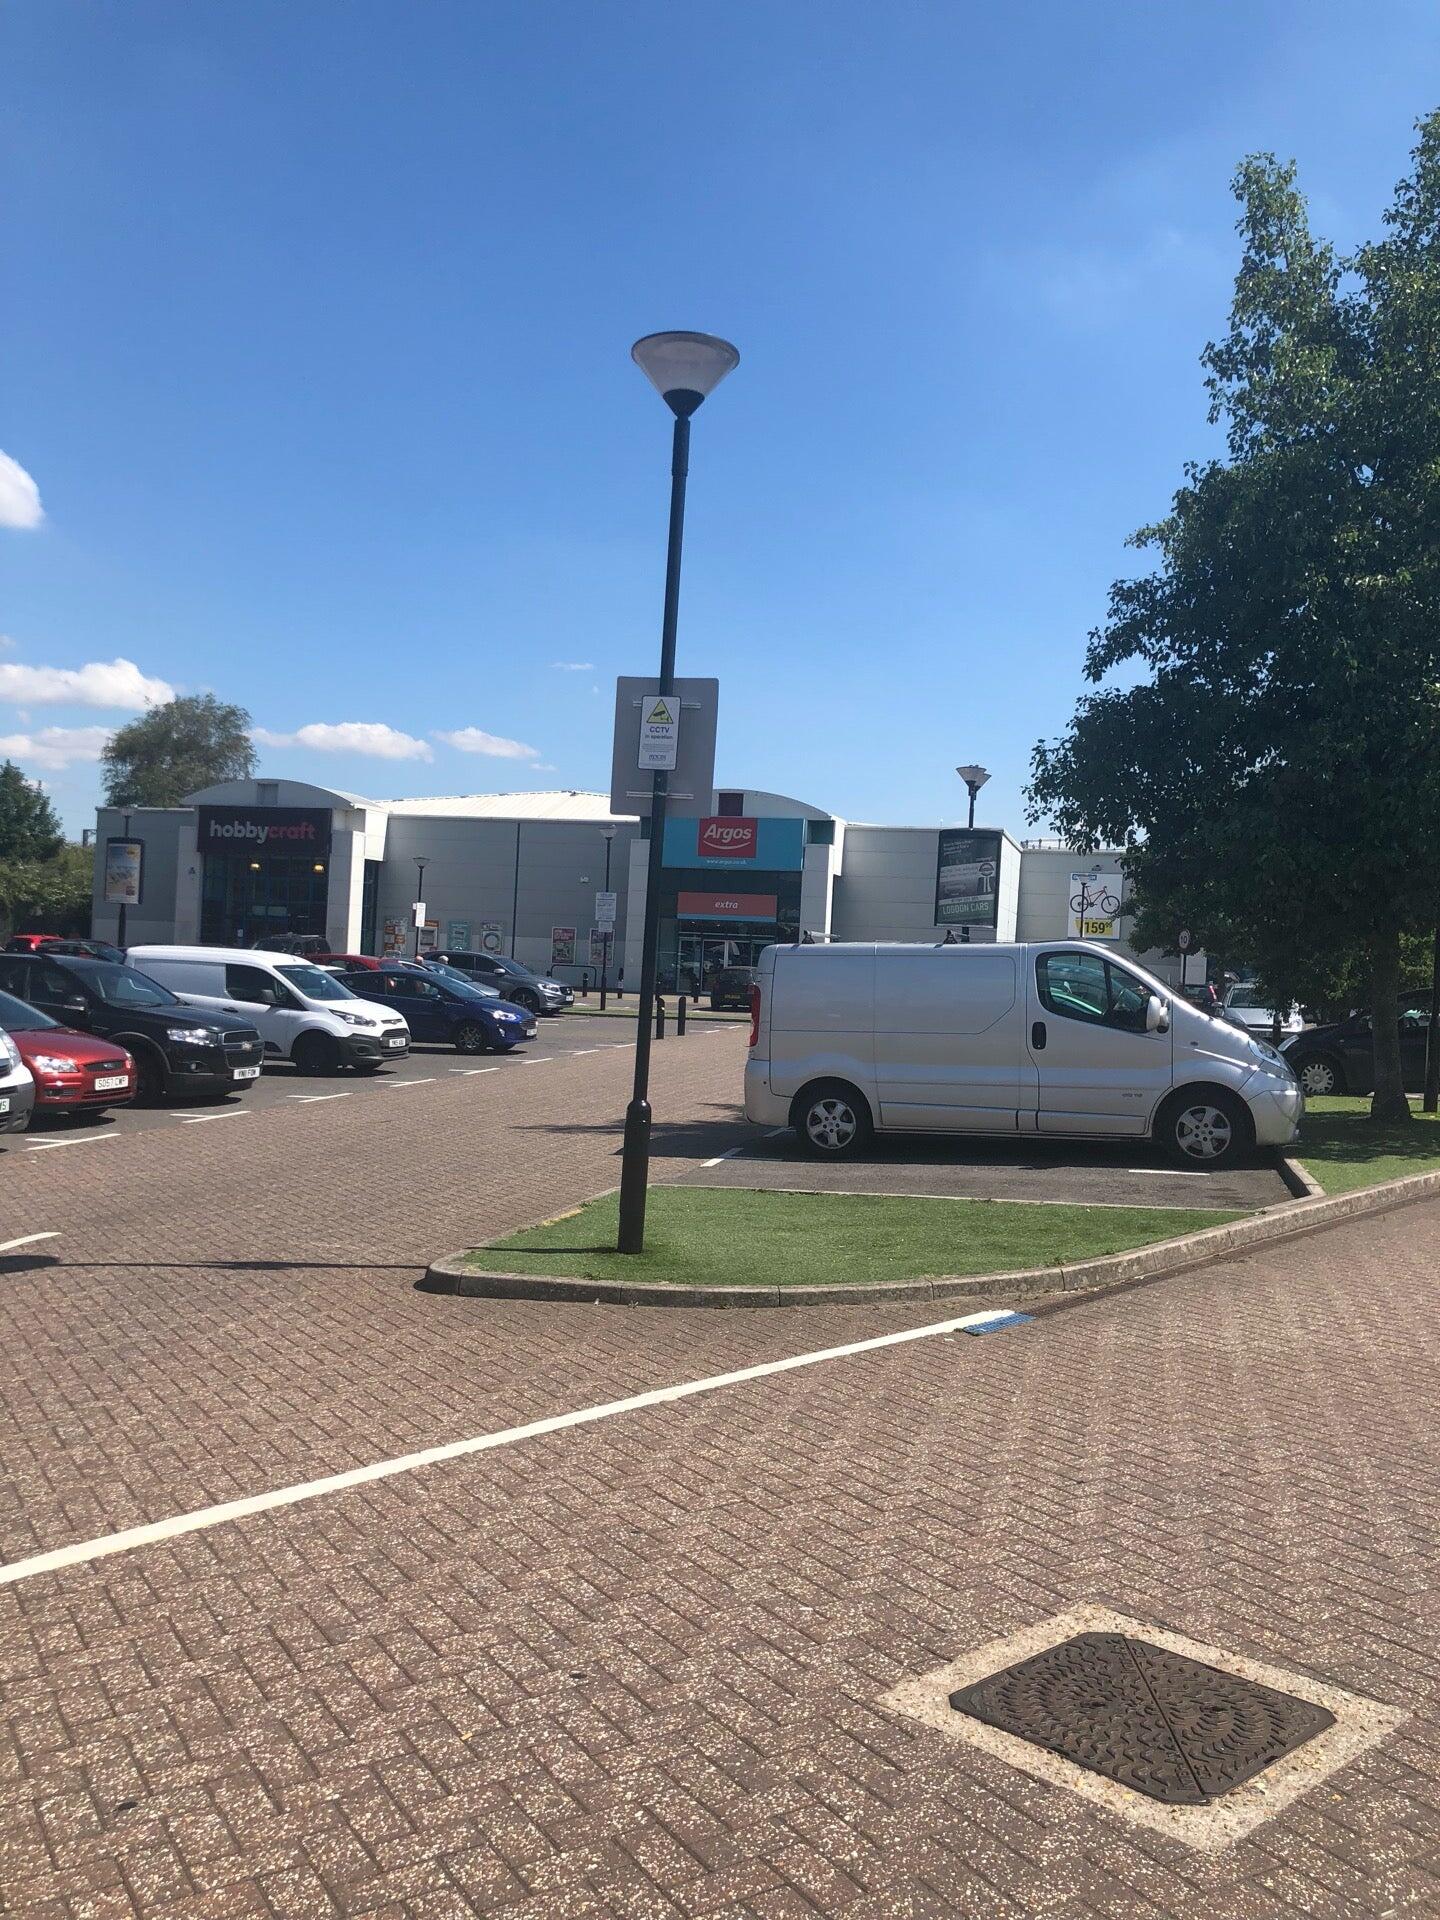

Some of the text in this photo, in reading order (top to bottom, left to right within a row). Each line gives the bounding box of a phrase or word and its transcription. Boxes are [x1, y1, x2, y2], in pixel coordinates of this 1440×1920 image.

[210, 820, 316, 844] hobbycraft
[704, 823, 752, 843] Argos
[714, 900, 739, 909] extra
[970, 902, 989, 912] CARS
